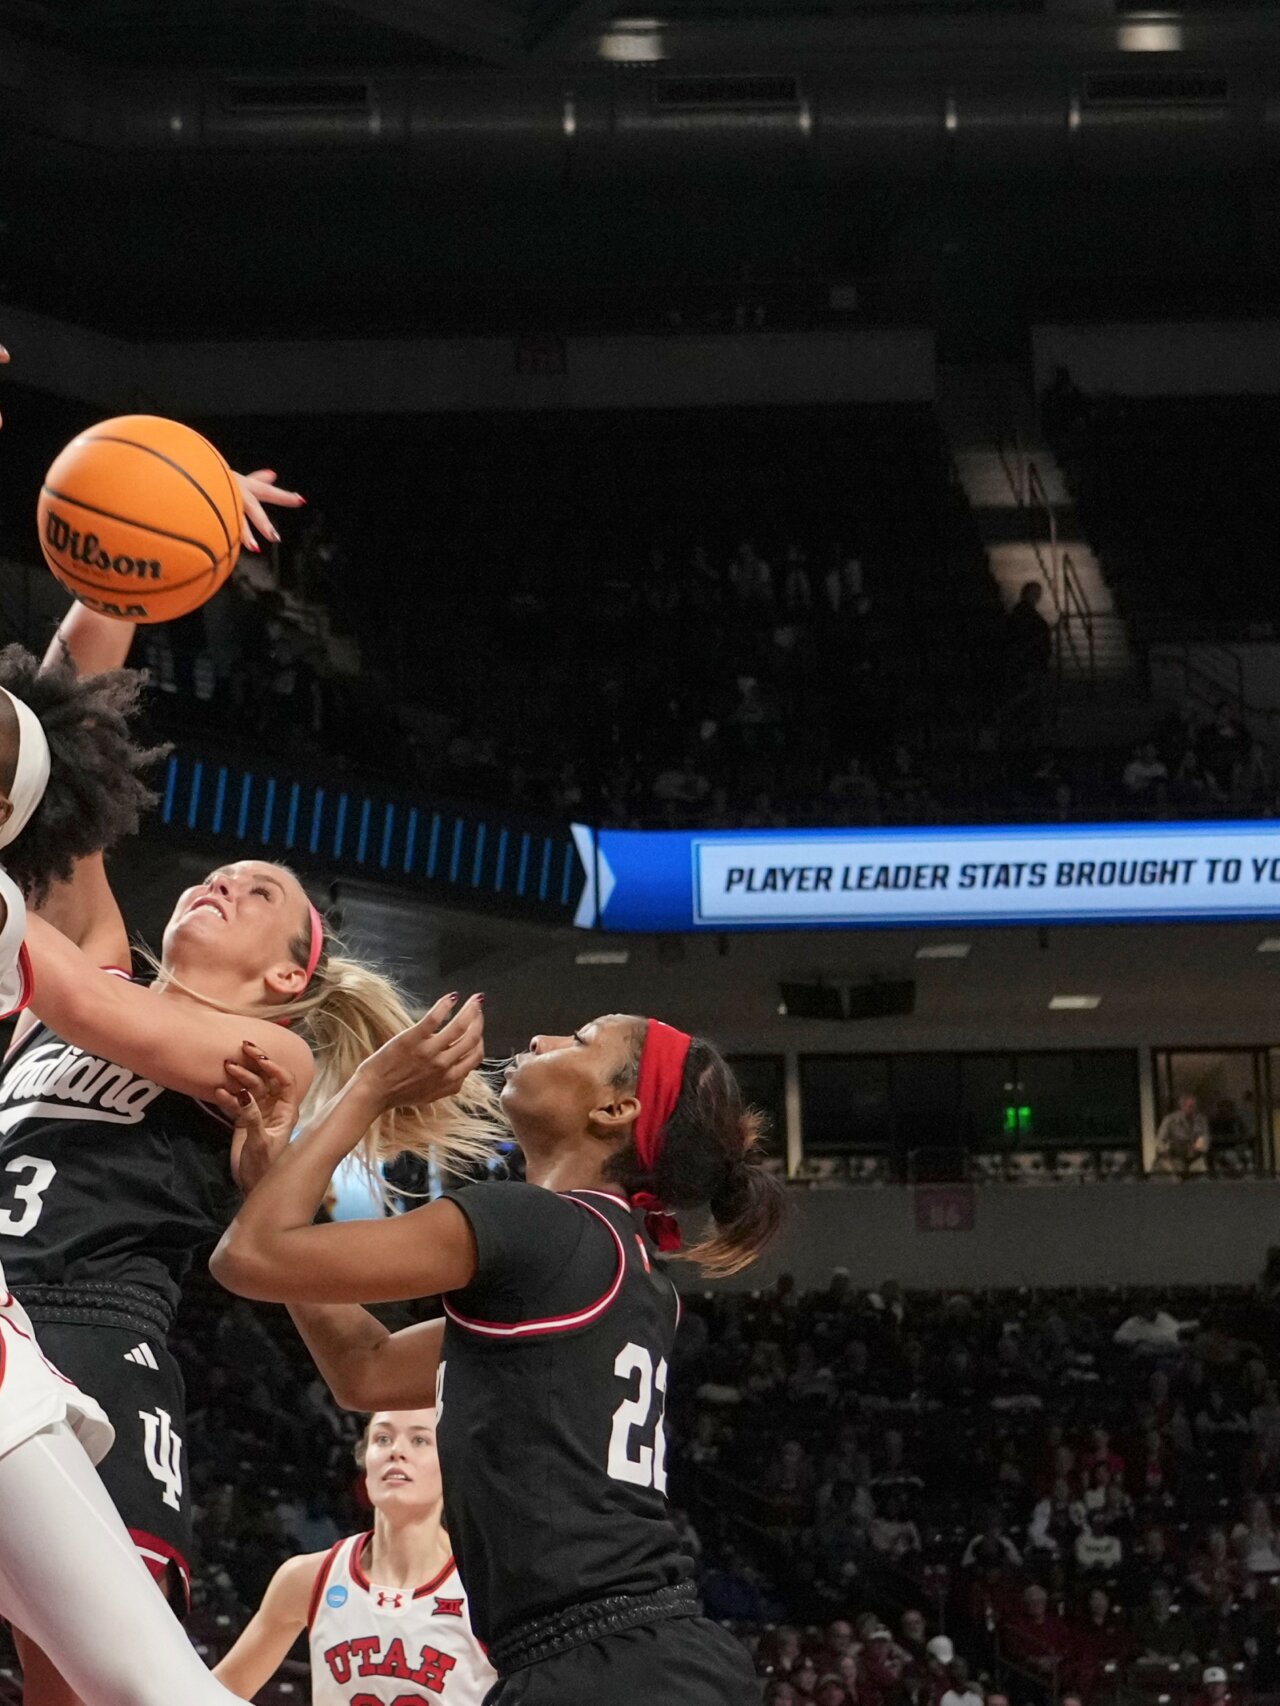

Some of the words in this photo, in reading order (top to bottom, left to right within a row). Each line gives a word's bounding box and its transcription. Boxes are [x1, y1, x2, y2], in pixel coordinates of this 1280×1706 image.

[47, 510, 162, 580] Wilson
[725, 865, 834, 893] PLAYER
[841, 863, 950, 891] LEADER
[958, 862, 1048, 889] STATS
[1054, 859, 1198, 888] BROUGHT
[1205, 857, 1243, 885] TO
[324, 1635, 457, 1694] UTAH
